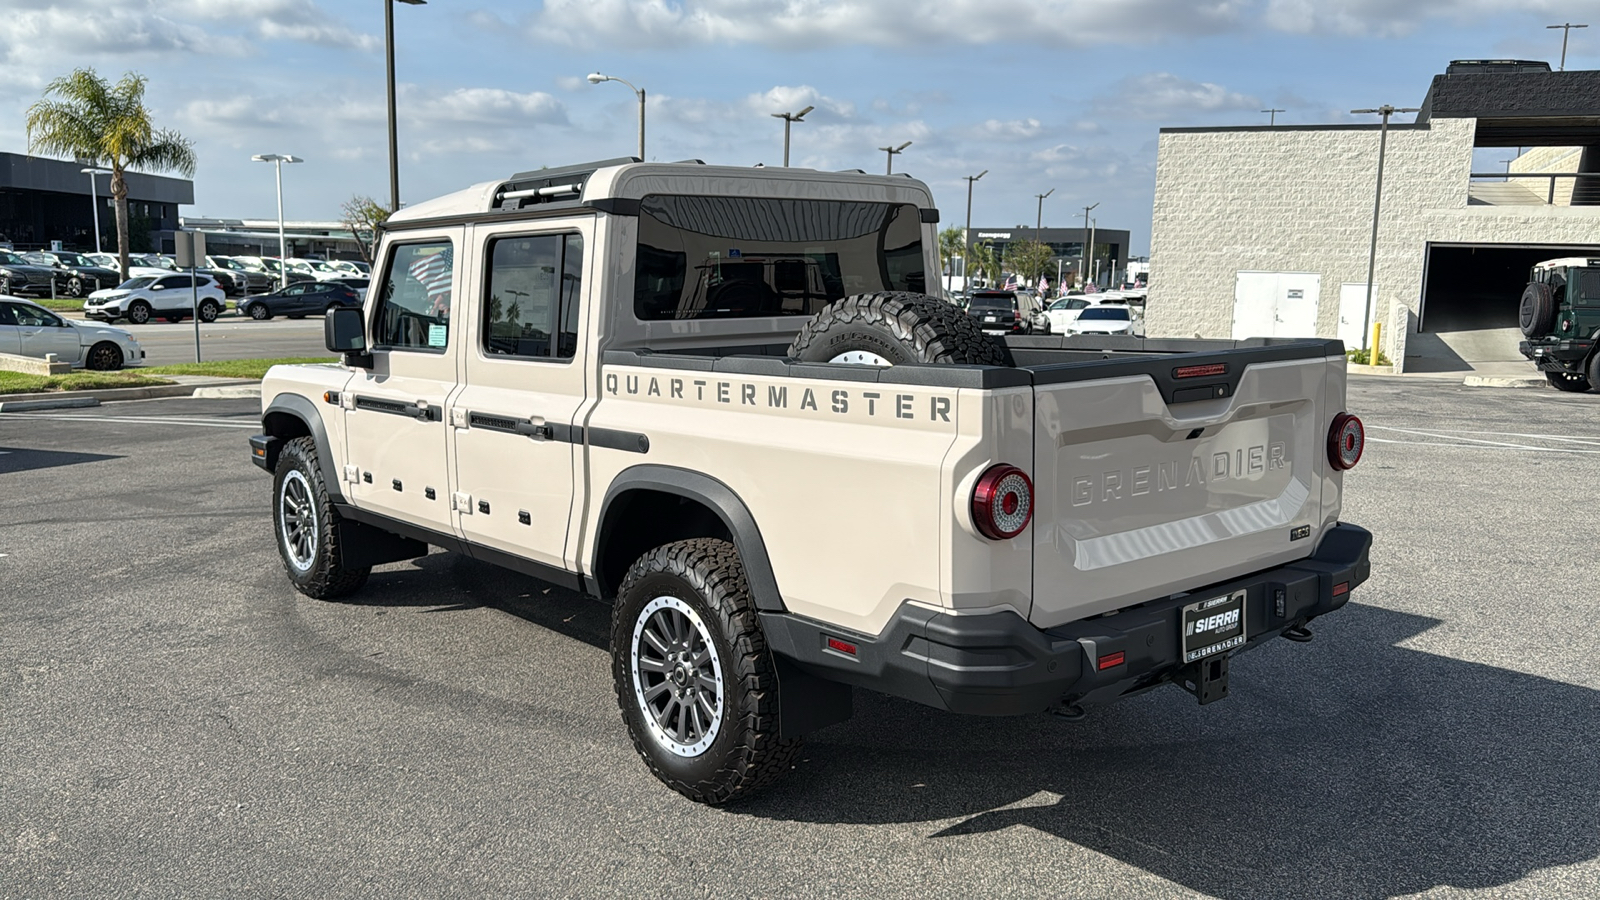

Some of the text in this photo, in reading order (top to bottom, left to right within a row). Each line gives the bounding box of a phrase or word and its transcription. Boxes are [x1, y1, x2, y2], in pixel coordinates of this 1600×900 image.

[605, 372, 952, 423] QUARTERMASTER
[1070, 440, 1286, 508] GRENADIER
[1207, 596, 1228, 607] SIERRA
[1195, 608, 1240, 633] SIERRA
[1201, 636, 1243, 656] GRENADIER
